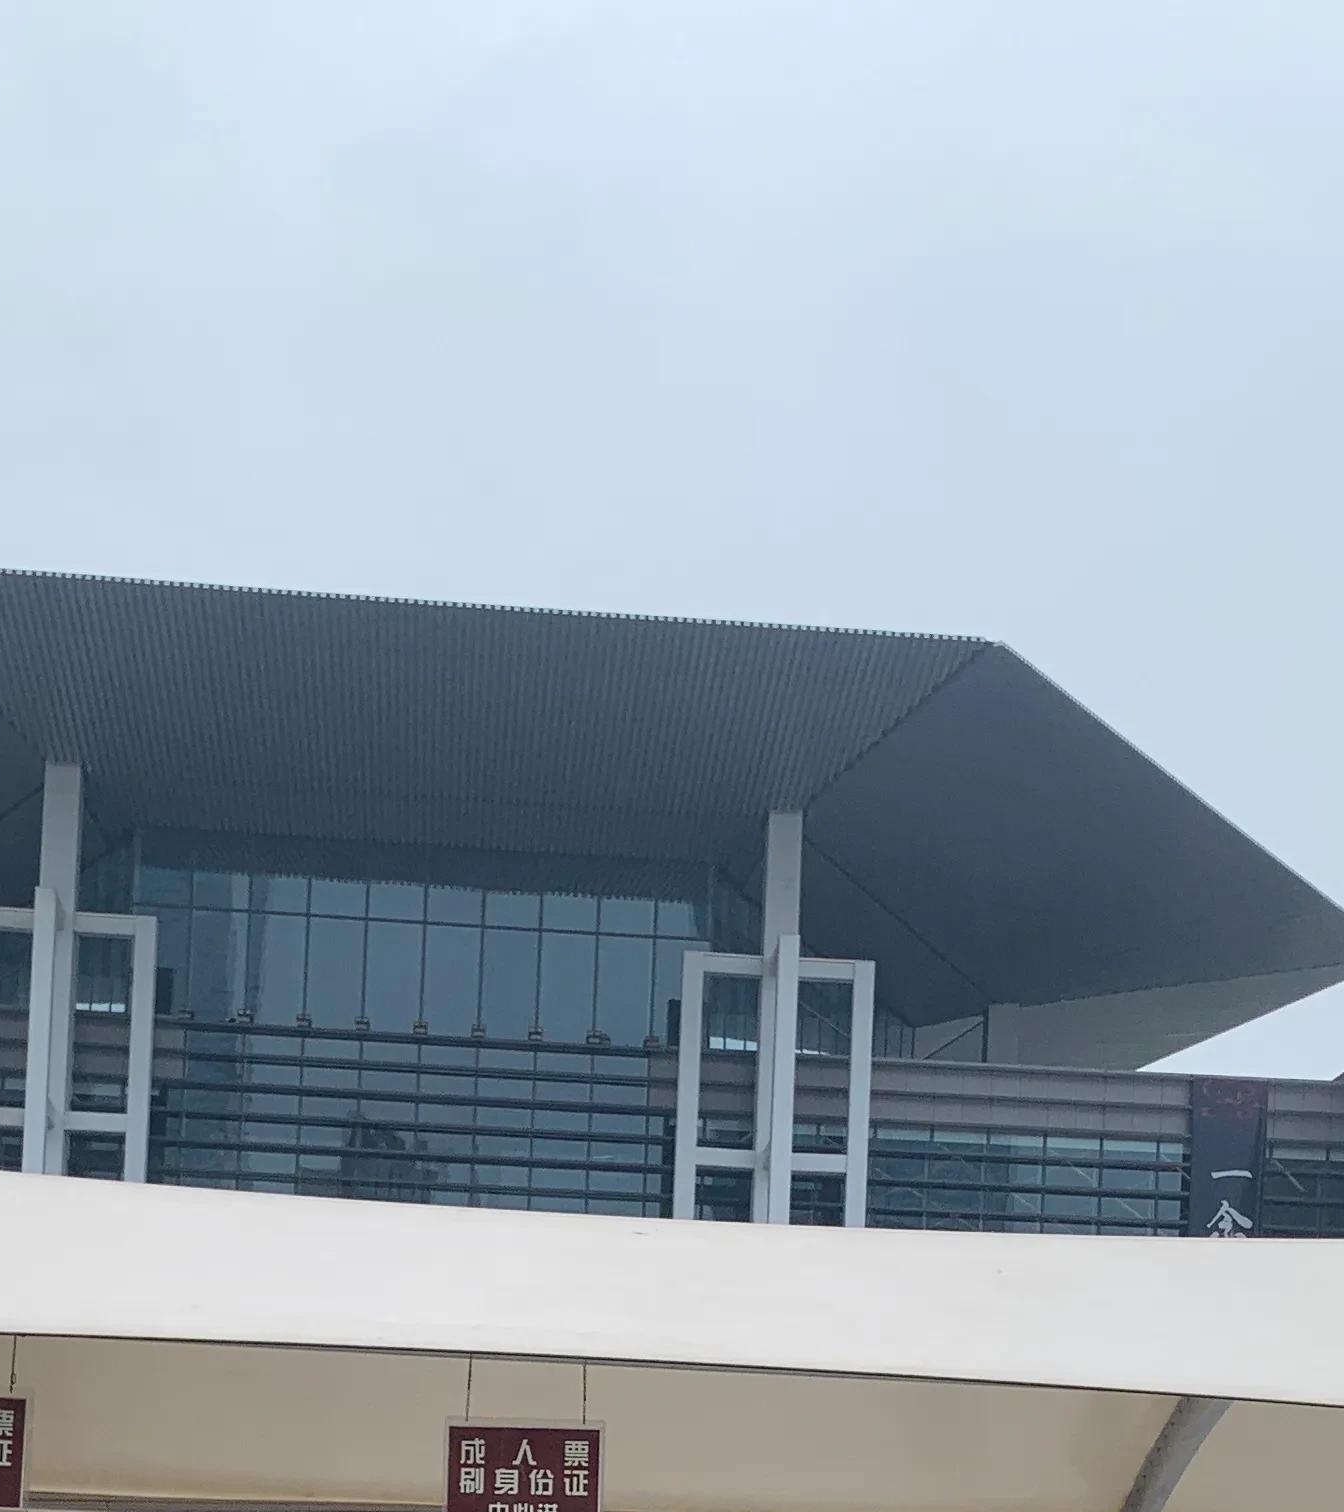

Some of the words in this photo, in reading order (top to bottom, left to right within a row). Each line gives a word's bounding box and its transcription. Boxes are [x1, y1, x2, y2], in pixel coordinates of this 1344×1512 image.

[459, 1437, 589, 1467] 成人票
[459, 1467, 589, 1497] 刷身份证
